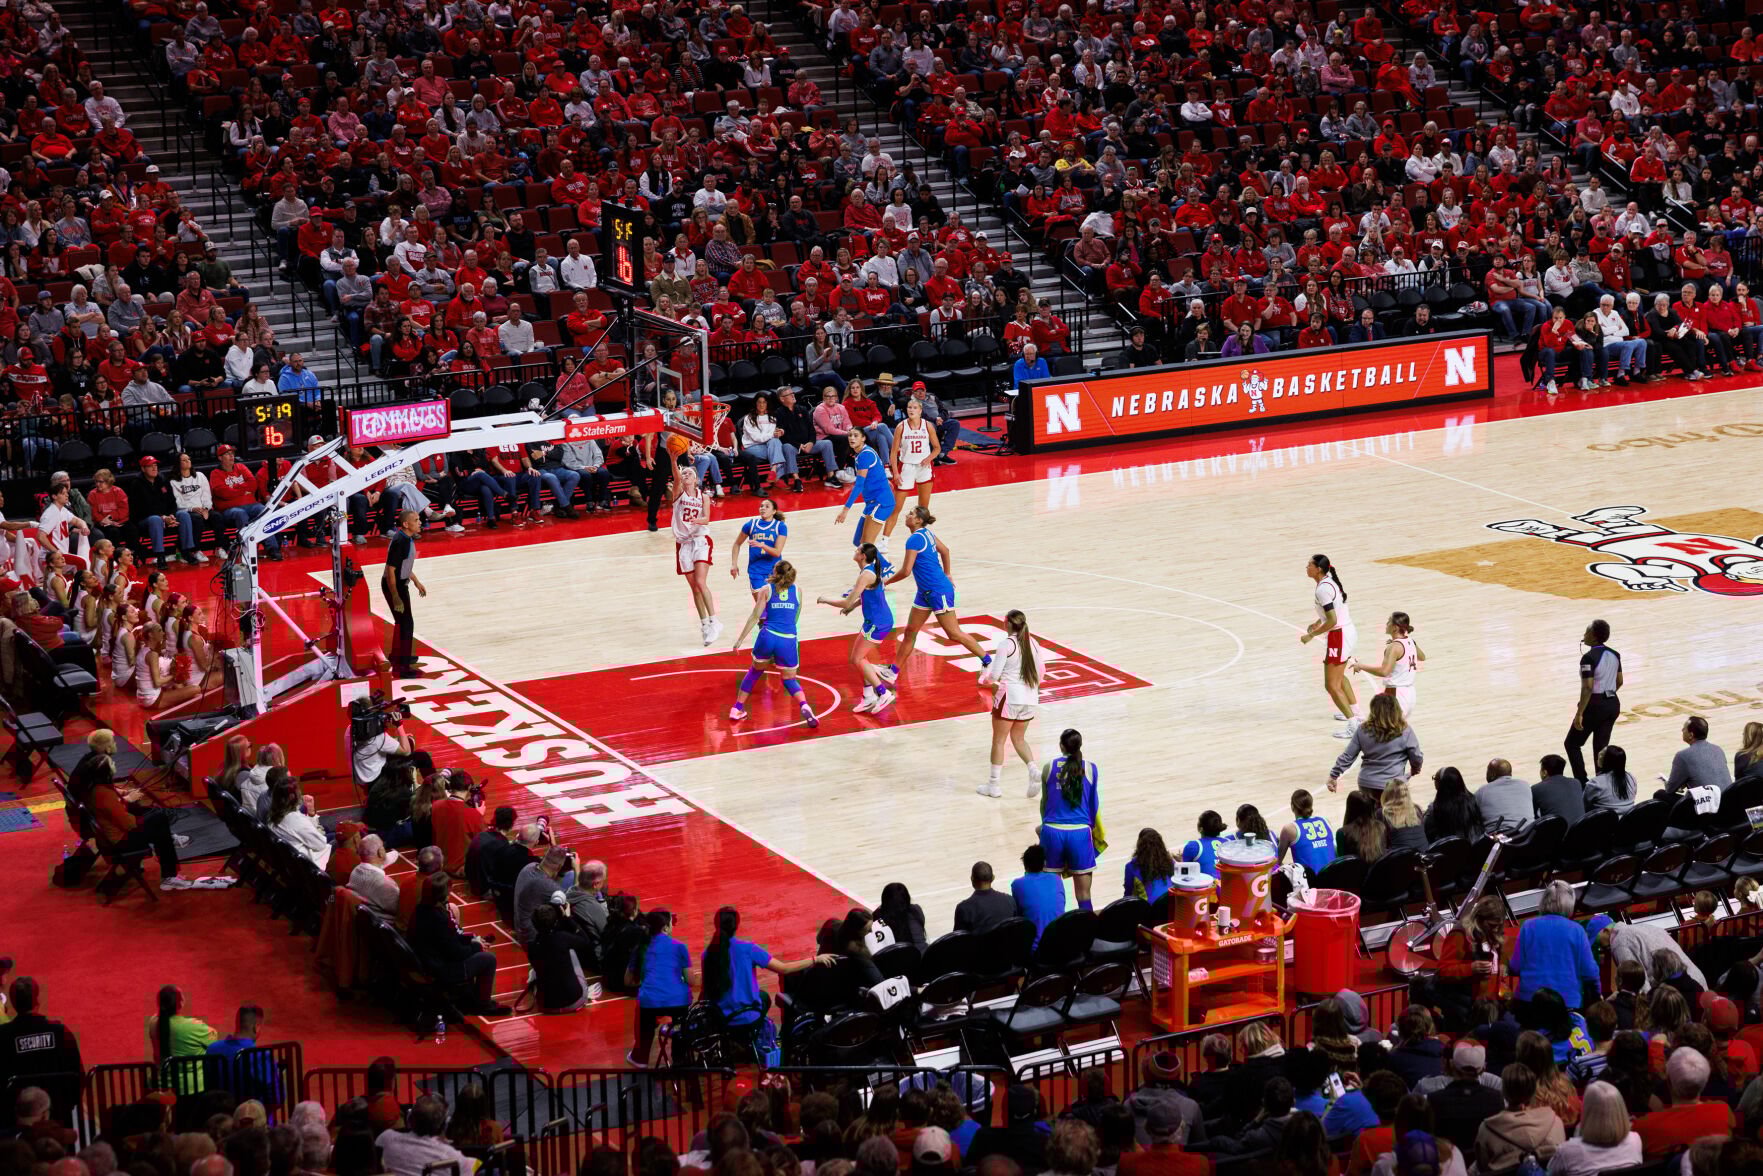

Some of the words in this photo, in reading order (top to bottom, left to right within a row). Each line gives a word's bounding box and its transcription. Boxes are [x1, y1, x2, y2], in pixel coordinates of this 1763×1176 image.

[1444, 346, 1477, 386] N
[1111, 383, 1238, 418] NEBRASKA
[1272, 361, 1418, 399] BASKETBALL
[255, 403, 292, 422] 5:19
[1045, 391, 1082, 434] N
[264, 426, 284, 446] 16
[910, 441, 923, 454] 12
[364, 458, 405, 482] LEGACY
[289, 493, 335, 520] SPORTS
[1328, 647, 1338, 658] N
[1302, 819, 1328, 840] 33
[1251, 875, 1269, 898] G
[1194, 898, 1208, 914] G
[1218, 935, 1252, 948] GATORADE
[19, 1033, 51, 1050] SECURITY
